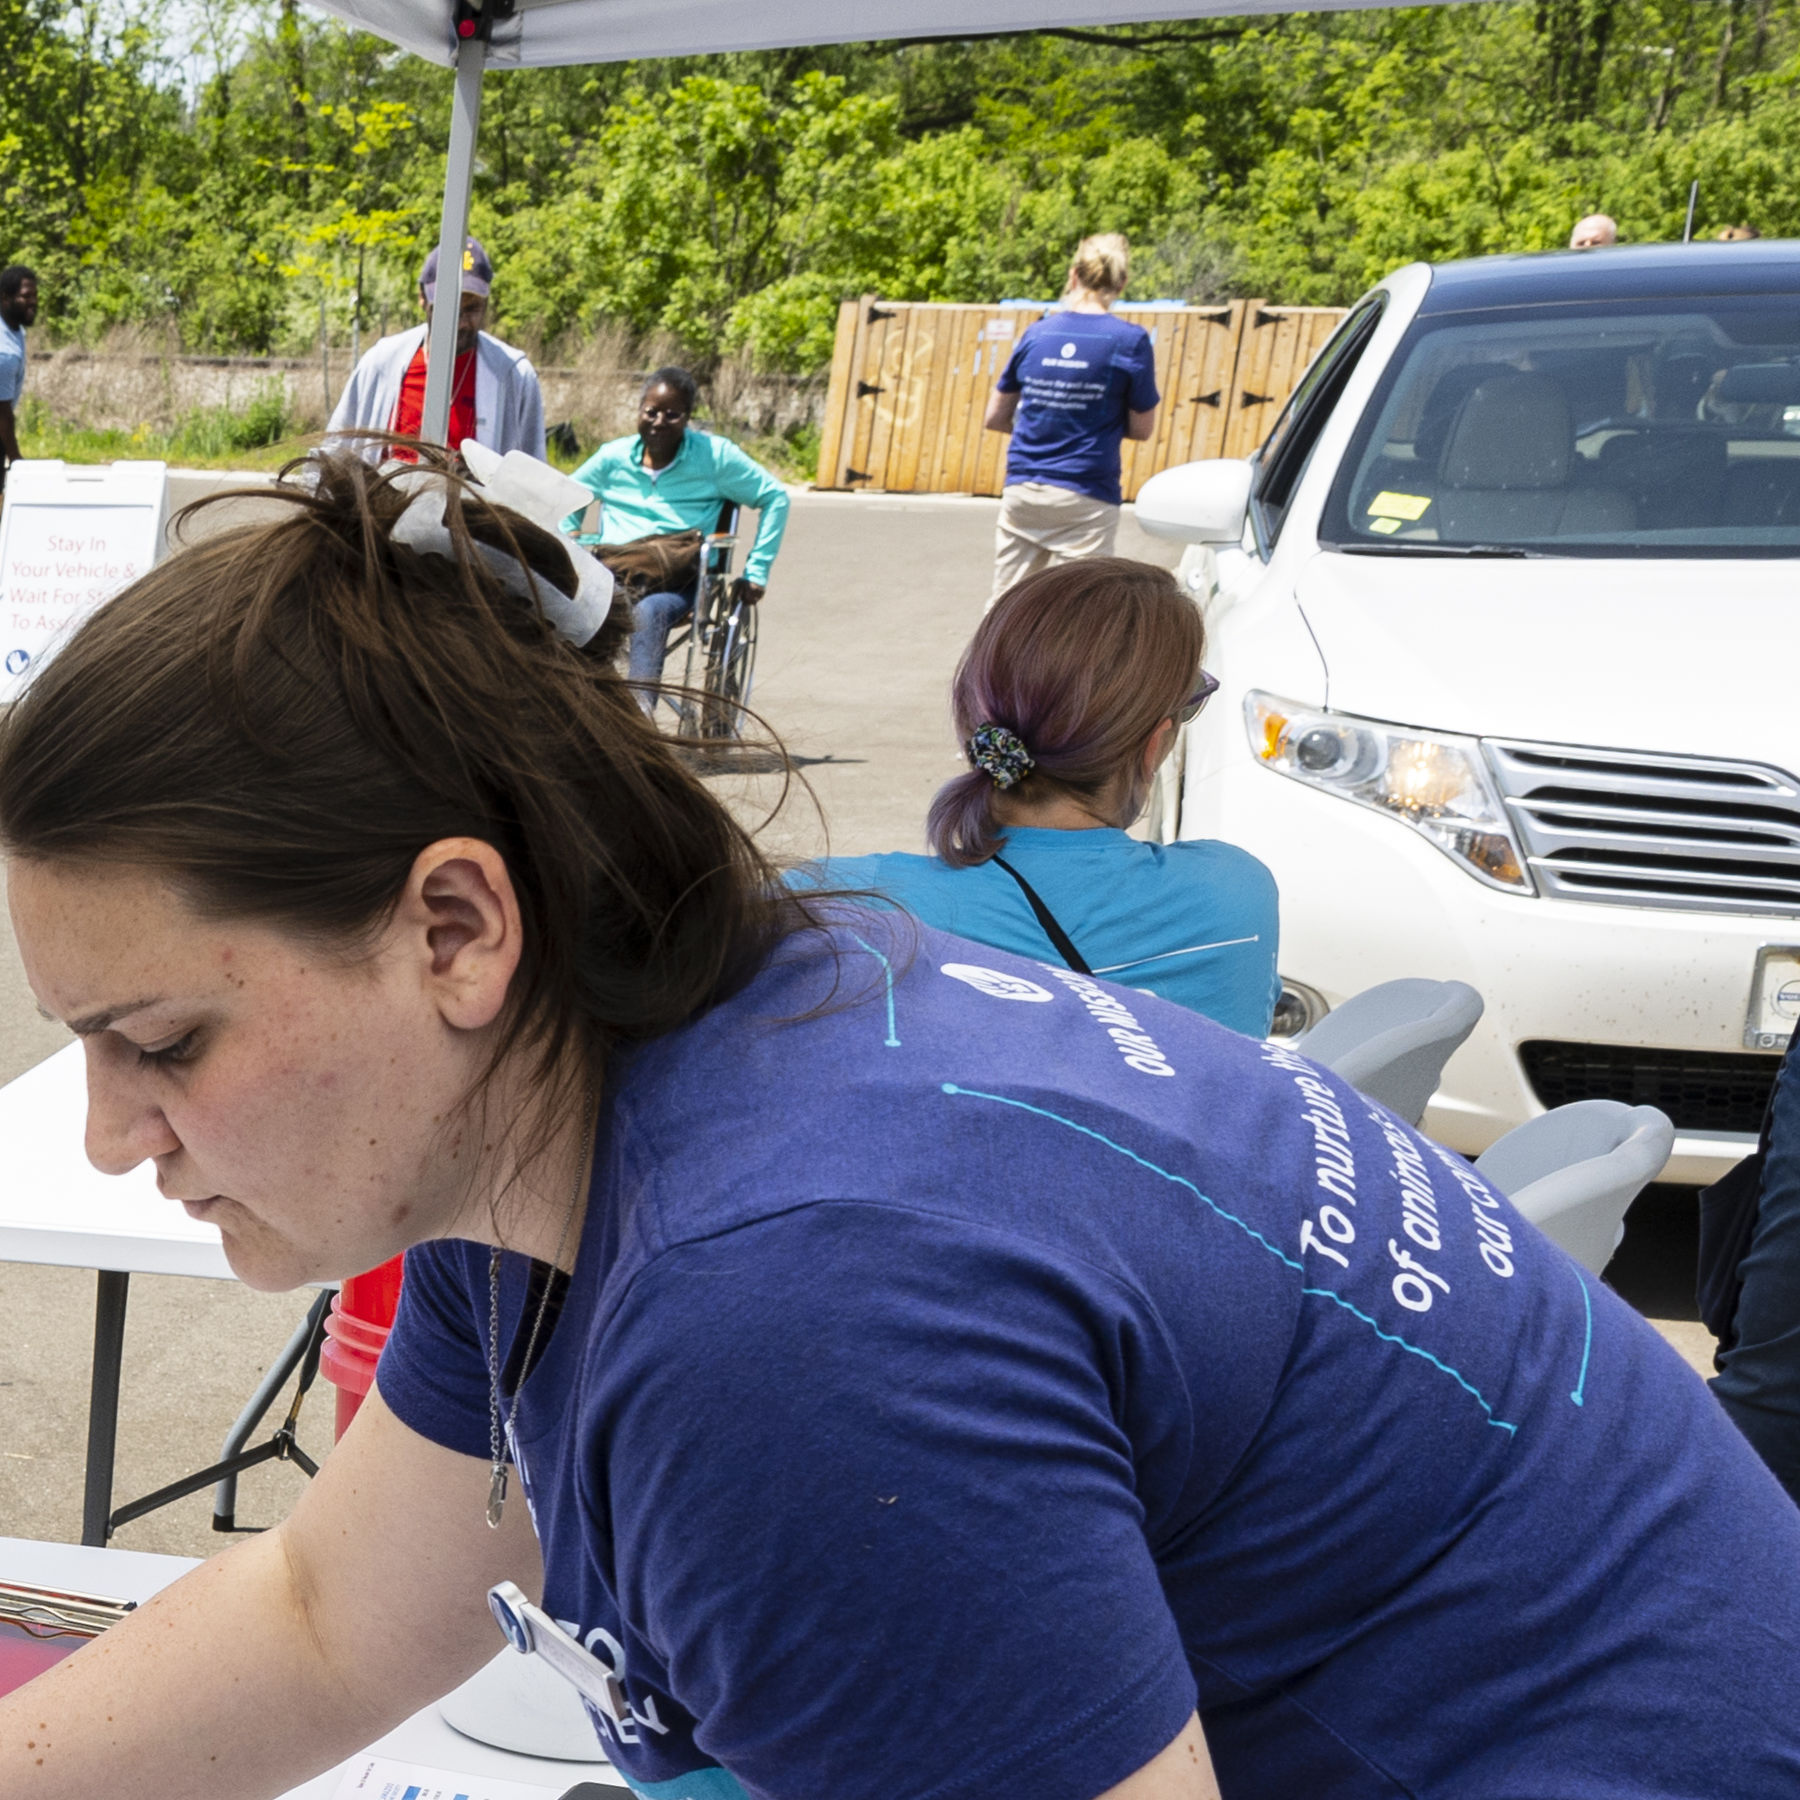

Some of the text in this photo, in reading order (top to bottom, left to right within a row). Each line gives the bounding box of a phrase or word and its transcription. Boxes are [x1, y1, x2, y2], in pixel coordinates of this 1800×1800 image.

[12, 561, 136, 578] Your Vehicle &
[48, 536, 106, 556] Stay In
[10, 588, 48, 604] Wait
[54, 588, 80, 603] For
[12, 614, 30, 630] To
[1106, 1027, 1176, 1077] OUR
[1294, 1076, 1357, 1207] nurture
[1300, 1204, 1356, 1269] To
[1470, 1200, 1515, 1278] our
[1387, 1237, 1451, 1313] of
